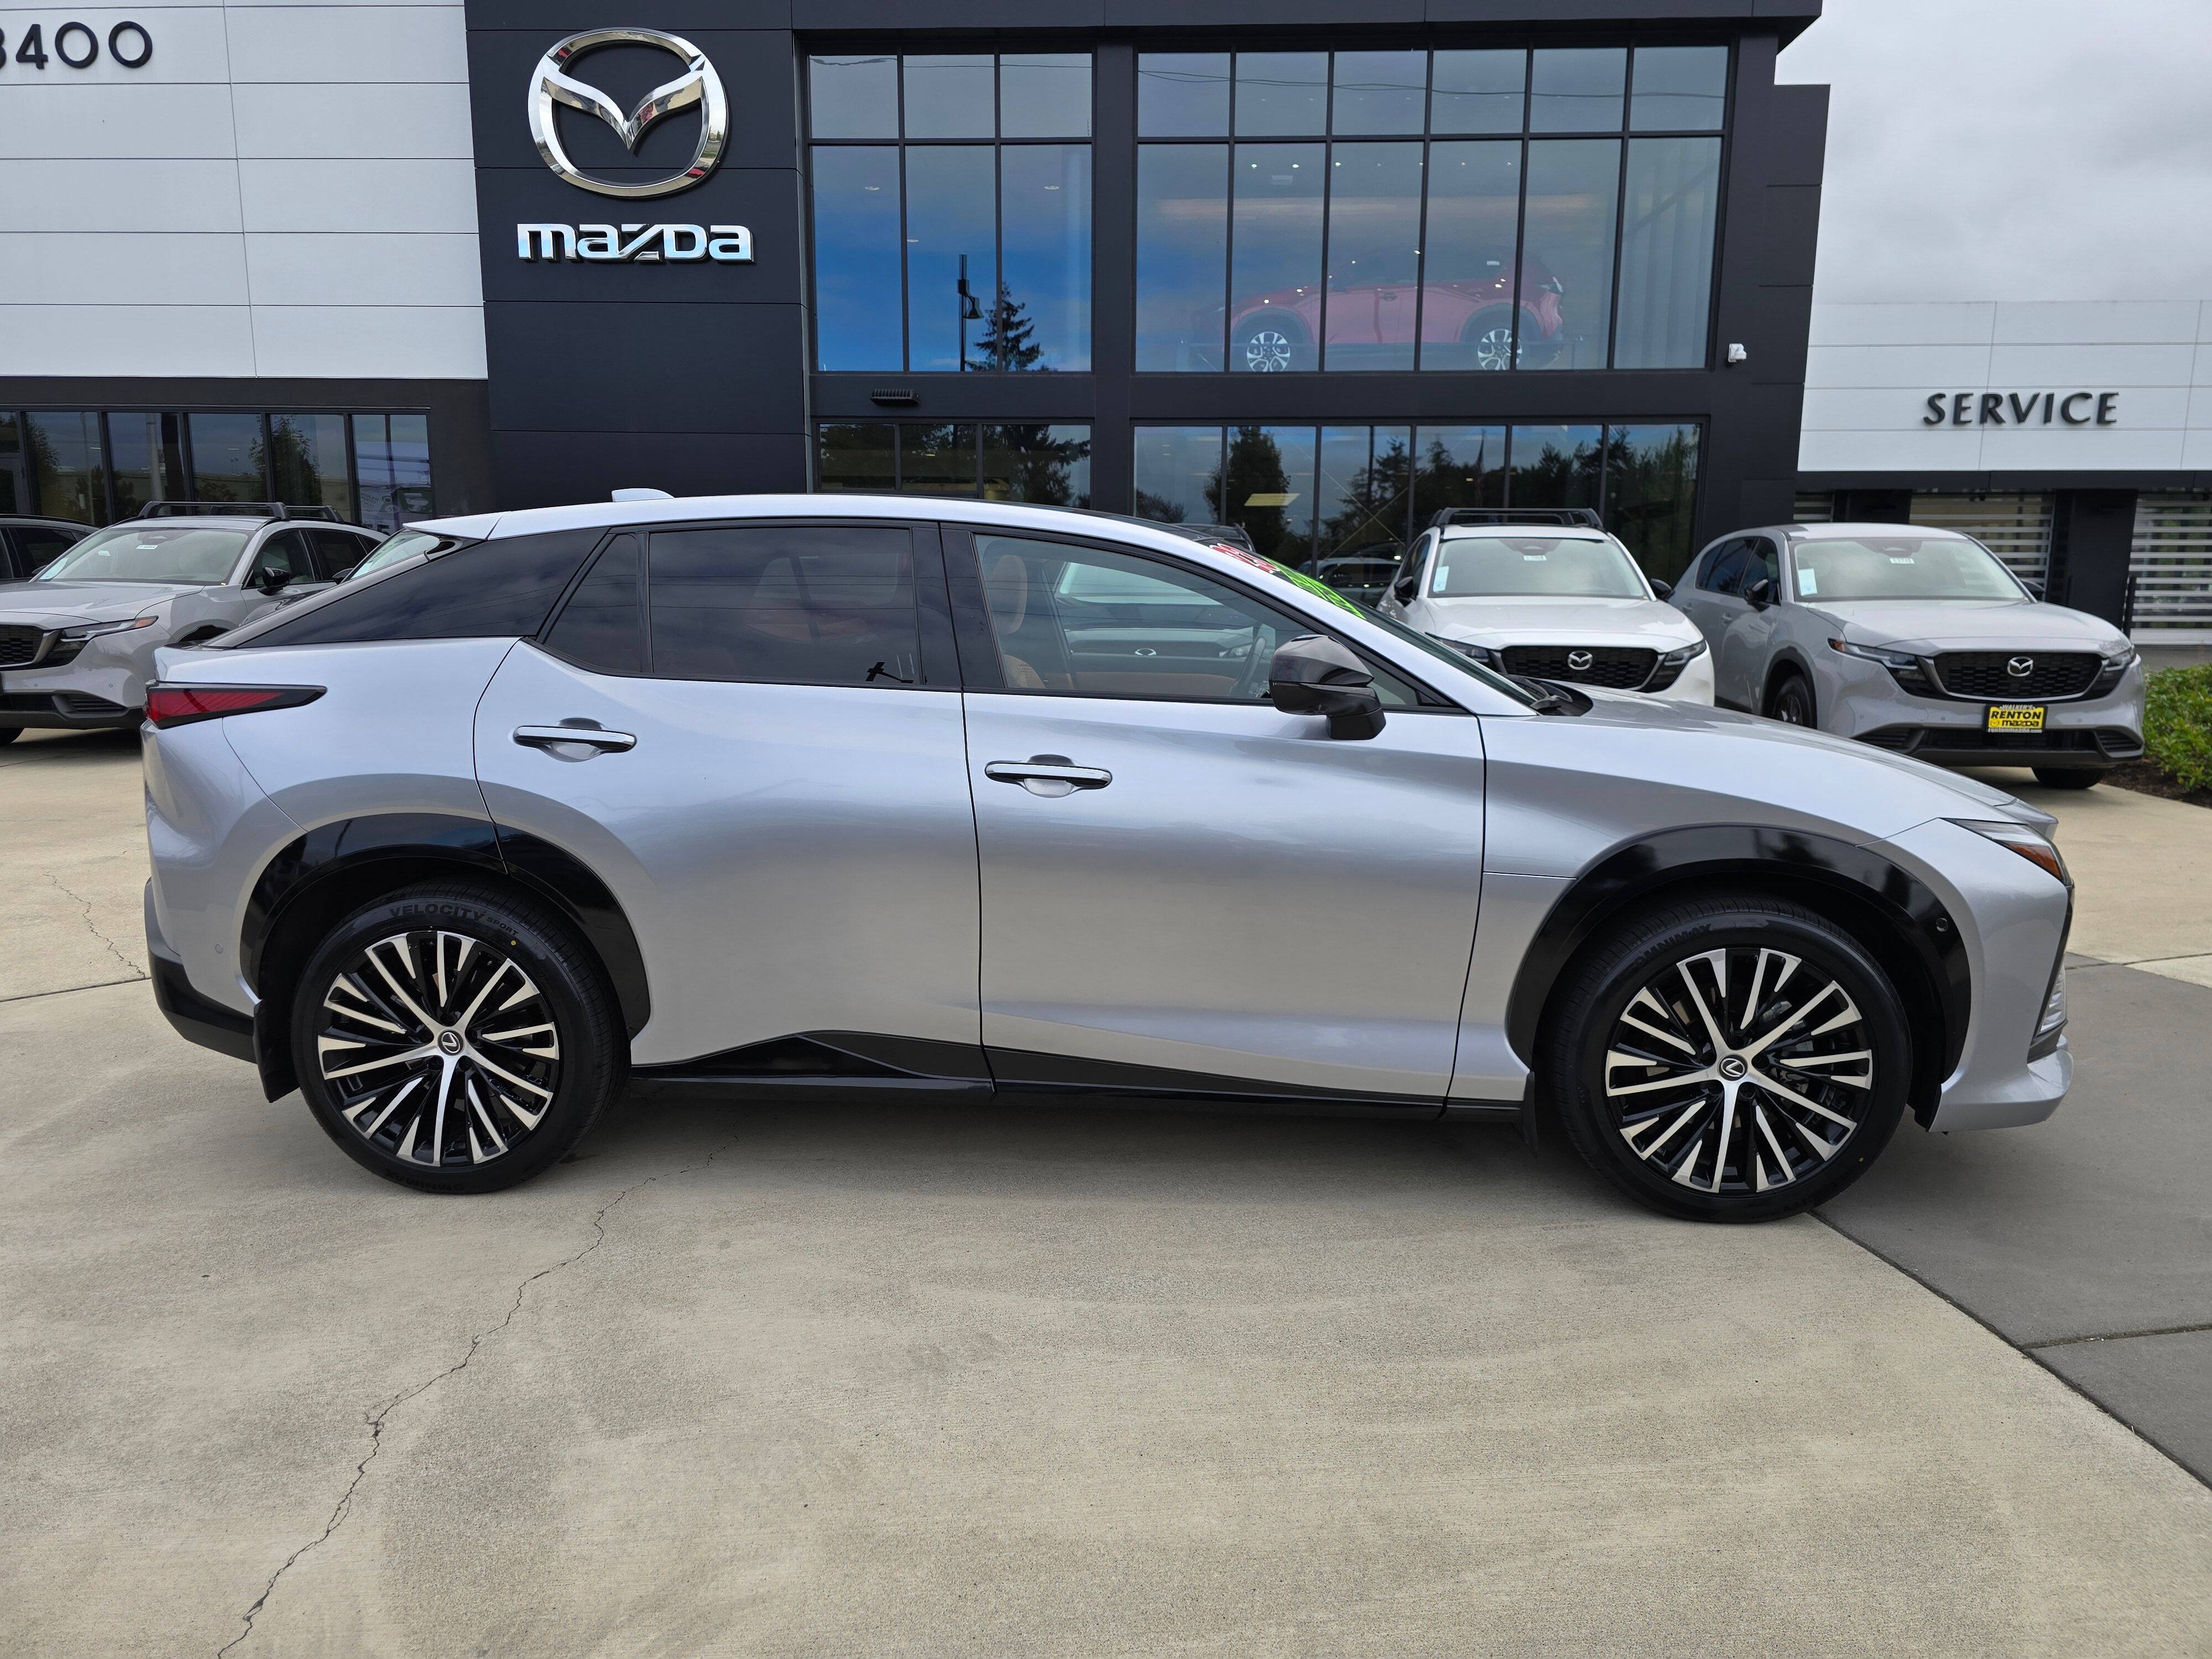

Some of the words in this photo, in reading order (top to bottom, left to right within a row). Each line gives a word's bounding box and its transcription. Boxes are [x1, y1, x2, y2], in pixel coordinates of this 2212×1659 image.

[0, 20, 153, 70] 400
[517, 223, 753, 263] mazda
[1923, 392, 2120, 425] SERVICE
[1991, 711, 2042, 719] RENTON
[389, 904, 486, 922] VELOCITY
[486, 916, 519, 936] SPORT
[1633, 923, 1713, 967] OMNIMAX
[384, 1168, 465, 1191] OMNIMAX
